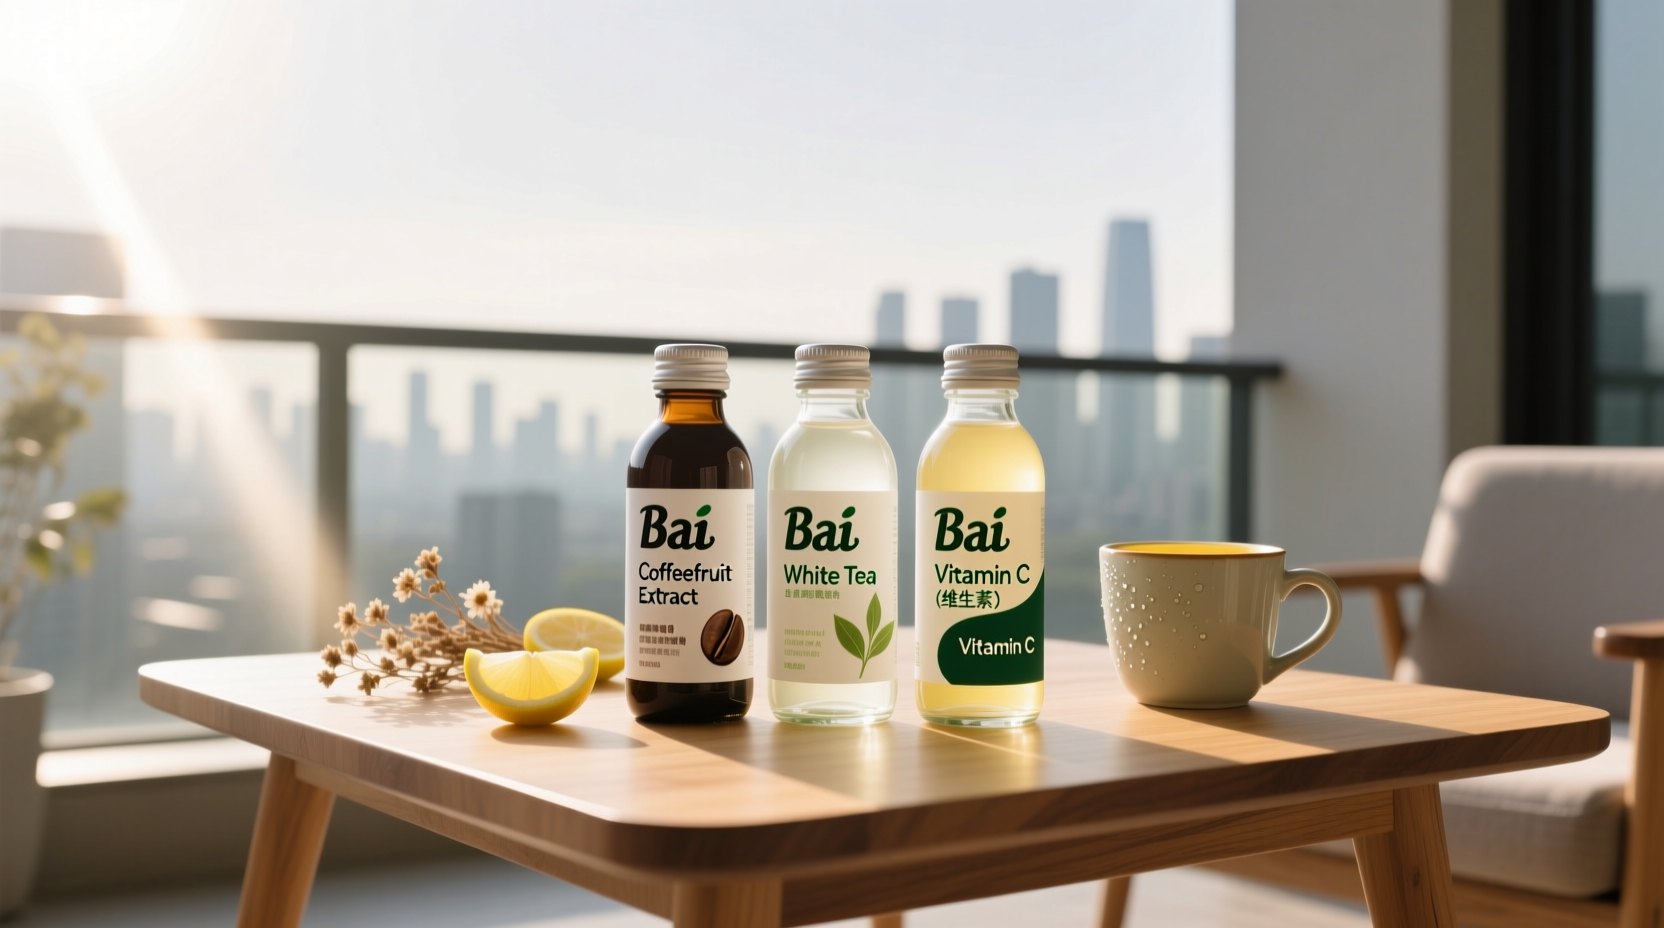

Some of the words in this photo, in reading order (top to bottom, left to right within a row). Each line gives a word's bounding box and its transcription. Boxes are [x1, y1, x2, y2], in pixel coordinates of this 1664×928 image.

[640, 504, 715, 551] Bai
[784, 506, 860, 552] Bai
[934, 506, 1010, 552] Bai
[639, 562, 733, 582] Coffeefruit
[784, 564, 840, 585] White
[844, 565, 877, 585] Tea
[934, 563, 1011, 585] Vitamin
[1016, 563, 1031, 584] C
[639, 586, 699, 605] Extract
[958, 637, 1022, 656] Vitamin
[1024, 636, 1035, 654] C
